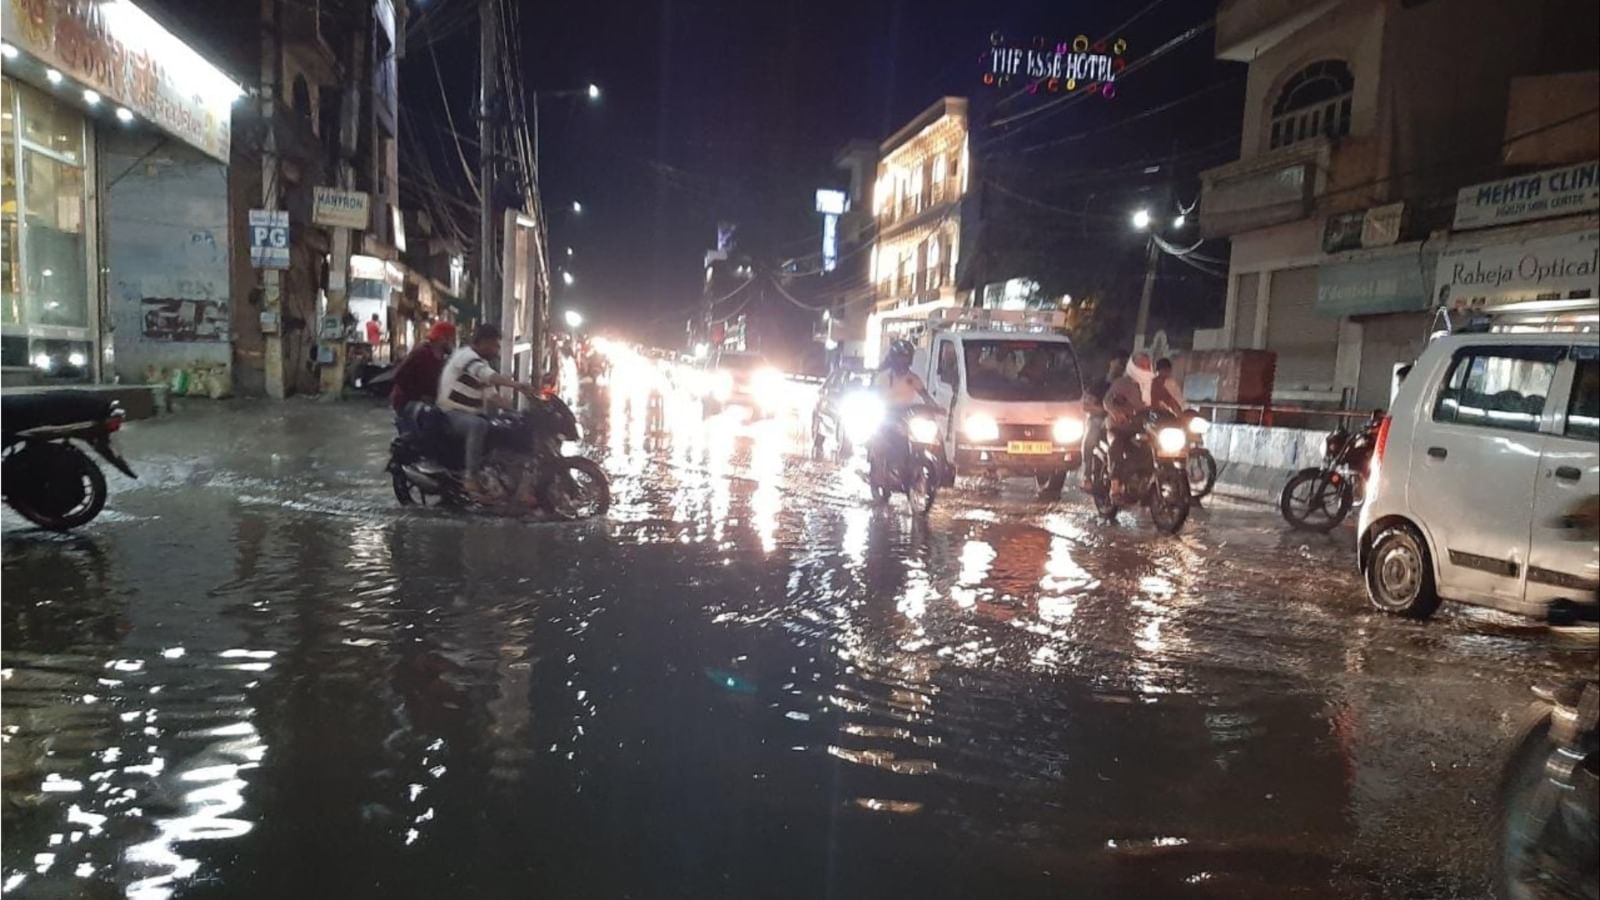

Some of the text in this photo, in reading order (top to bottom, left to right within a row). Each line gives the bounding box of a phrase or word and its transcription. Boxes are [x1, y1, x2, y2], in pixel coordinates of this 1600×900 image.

[1066, 53, 1115, 82] HOTEL
[1476, 175, 1542, 206] MEHTA
[254, 227, 286, 248] PG
[1451, 247, 1598, 288] Raheja Optical
